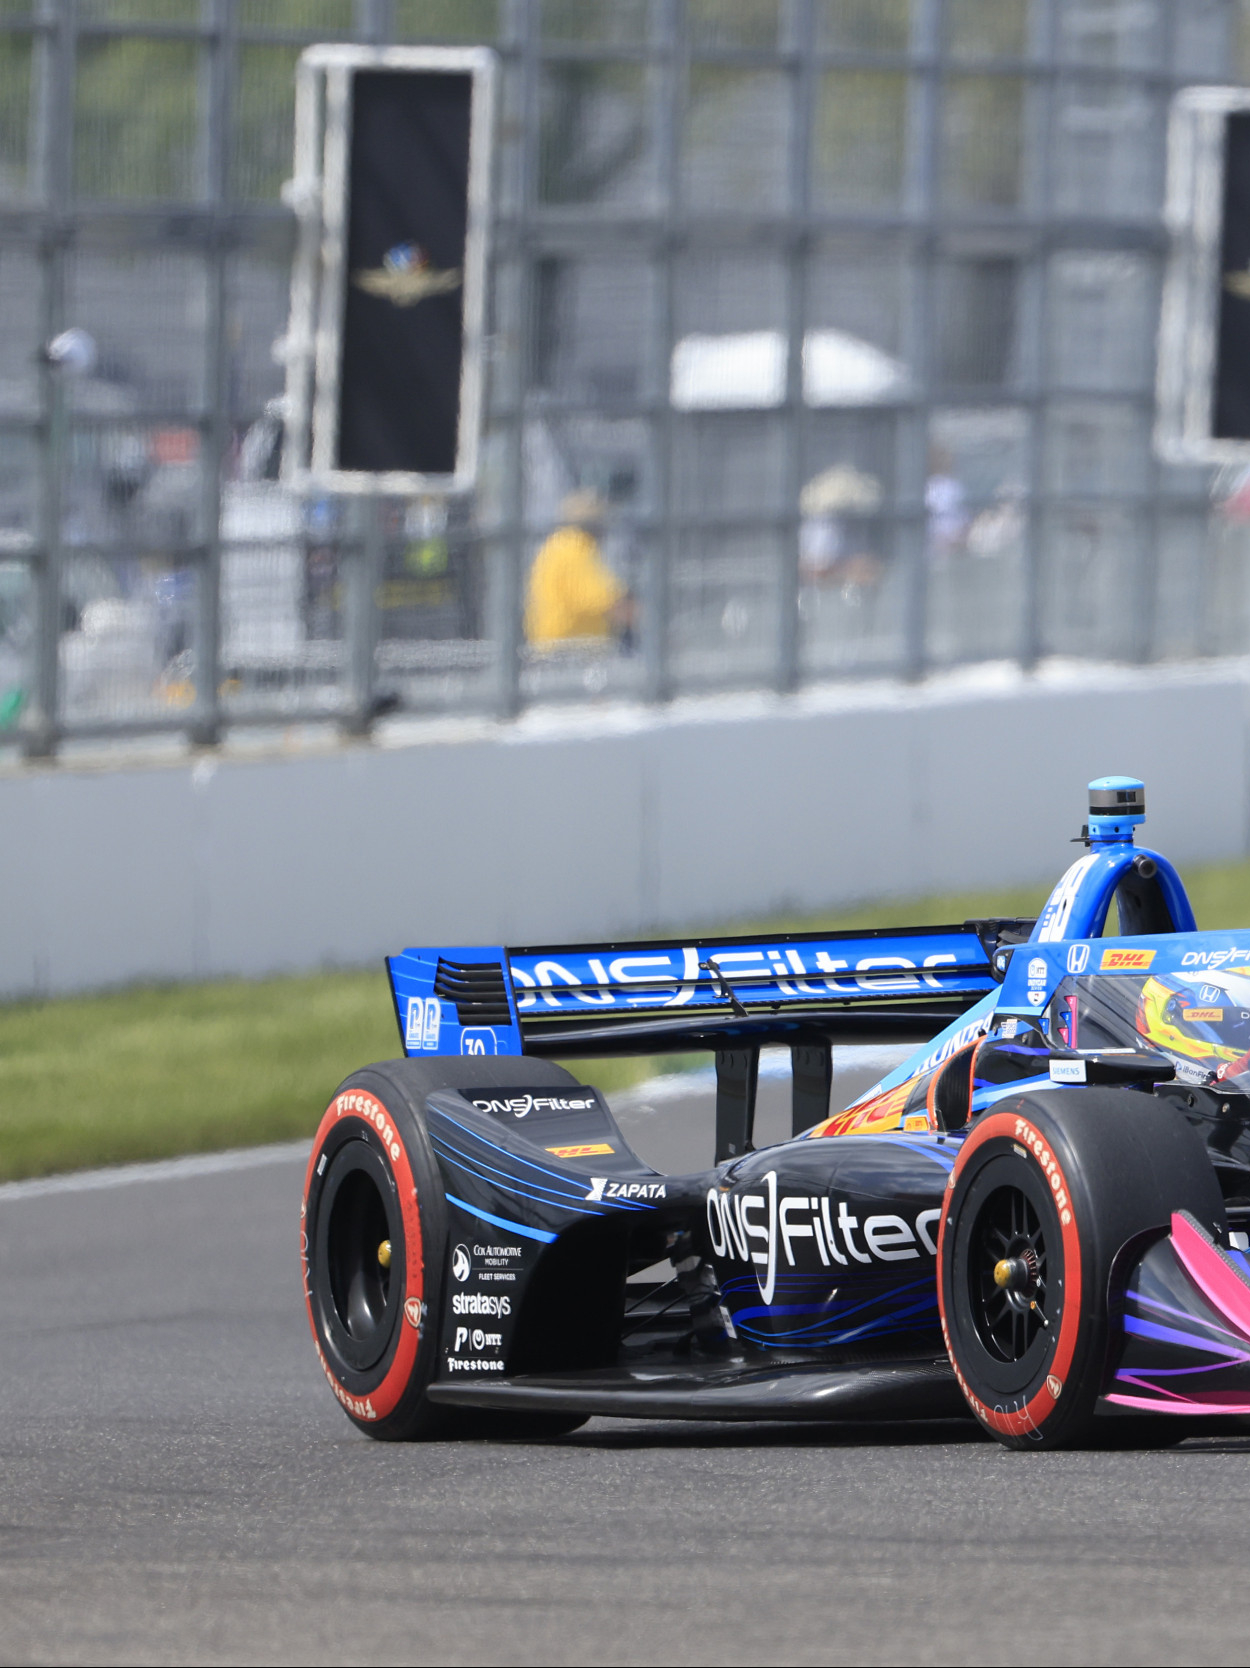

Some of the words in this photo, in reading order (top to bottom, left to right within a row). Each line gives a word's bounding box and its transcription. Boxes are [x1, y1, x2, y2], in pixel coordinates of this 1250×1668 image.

[1107, 953, 1147, 966] DHL
[1052, 1067, 1080, 1076] SIEMENS
[336, 1093, 400, 1162] Firestone
[1015, 1119, 1072, 1227] Firestone
[606, 1183, 667, 1198] ZAPATA
[485, 1258, 509, 1266] MOBILITY
[452, 1292, 511, 1319] stratasys
[485, 1333, 502, 1346] NTT
[447, 1357, 505, 1372] Firestone
